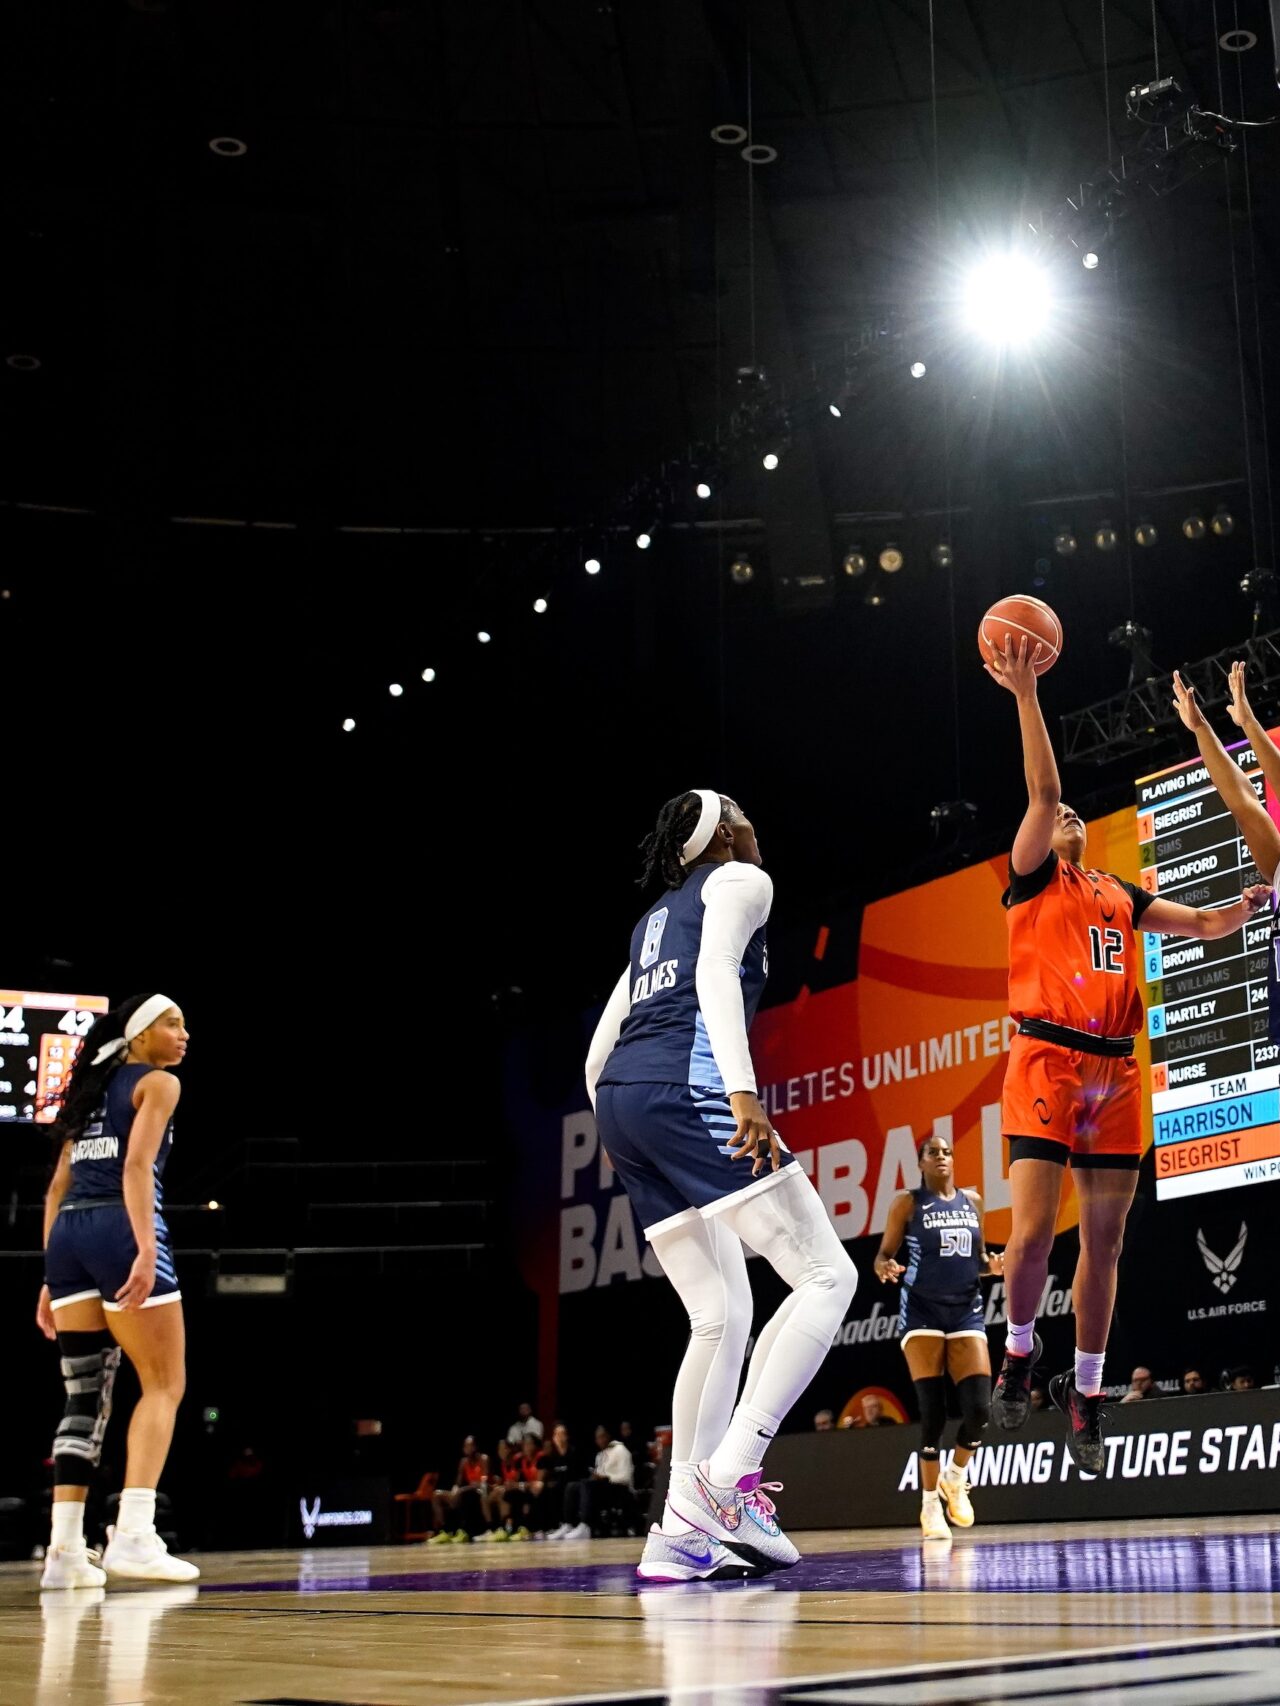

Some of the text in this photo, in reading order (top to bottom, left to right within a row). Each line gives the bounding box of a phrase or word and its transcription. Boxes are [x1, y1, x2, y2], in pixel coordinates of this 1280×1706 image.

[1238, 750, 1257, 767] PTS
[1142, 775, 1186, 802] PLAYING
[1143, 802, 1203, 835] 1 SIEGRIST
[1157, 838, 1182, 857] SIMS
[1146, 855, 1218, 891] 3 BRADFORD
[1244, 872, 1262, 887] 265
[639, 906, 669, 970] 8
[1087, 924, 1125, 975] 12
[1150, 945, 1205, 973] 6 BROWN
[1250, 957, 1269, 973] 246
[632, 958, 679, 1005] OLMES
[1177, 968, 1230, 993] WILLIAMS
[1153, 1000, 1217, 1030] 8 HARTLEY
[1167, 1028, 1228, 1054] CALDWELL
[1254, 1044, 1279, 1063] 2337
[757, 1016, 1014, 1116] HLETES UNLIMITED
[1168, 1062, 1207, 1083] NURSE
[1210, 1077, 1247, 1098] TEAM
[1159, 1102, 1253, 1140] HARRISON
[71, 1136, 119, 1164] ARRISON
[1160, 1138, 1241, 1172] SIEGRIST
[1243, 1164, 1267, 1181] WIN
[923, 1209, 978, 1222] ATHLETES
[923, 1218, 979, 1230] UNLIMITED
[939, 1228, 973, 1258] 50
[832, 1301, 901, 1347] aden
[1187, 1300, 1267, 1321] U.S. AIR FORCE
[898, 1451, 919, 1491] A
[1060, 1429, 1192, 1482] FTURE
